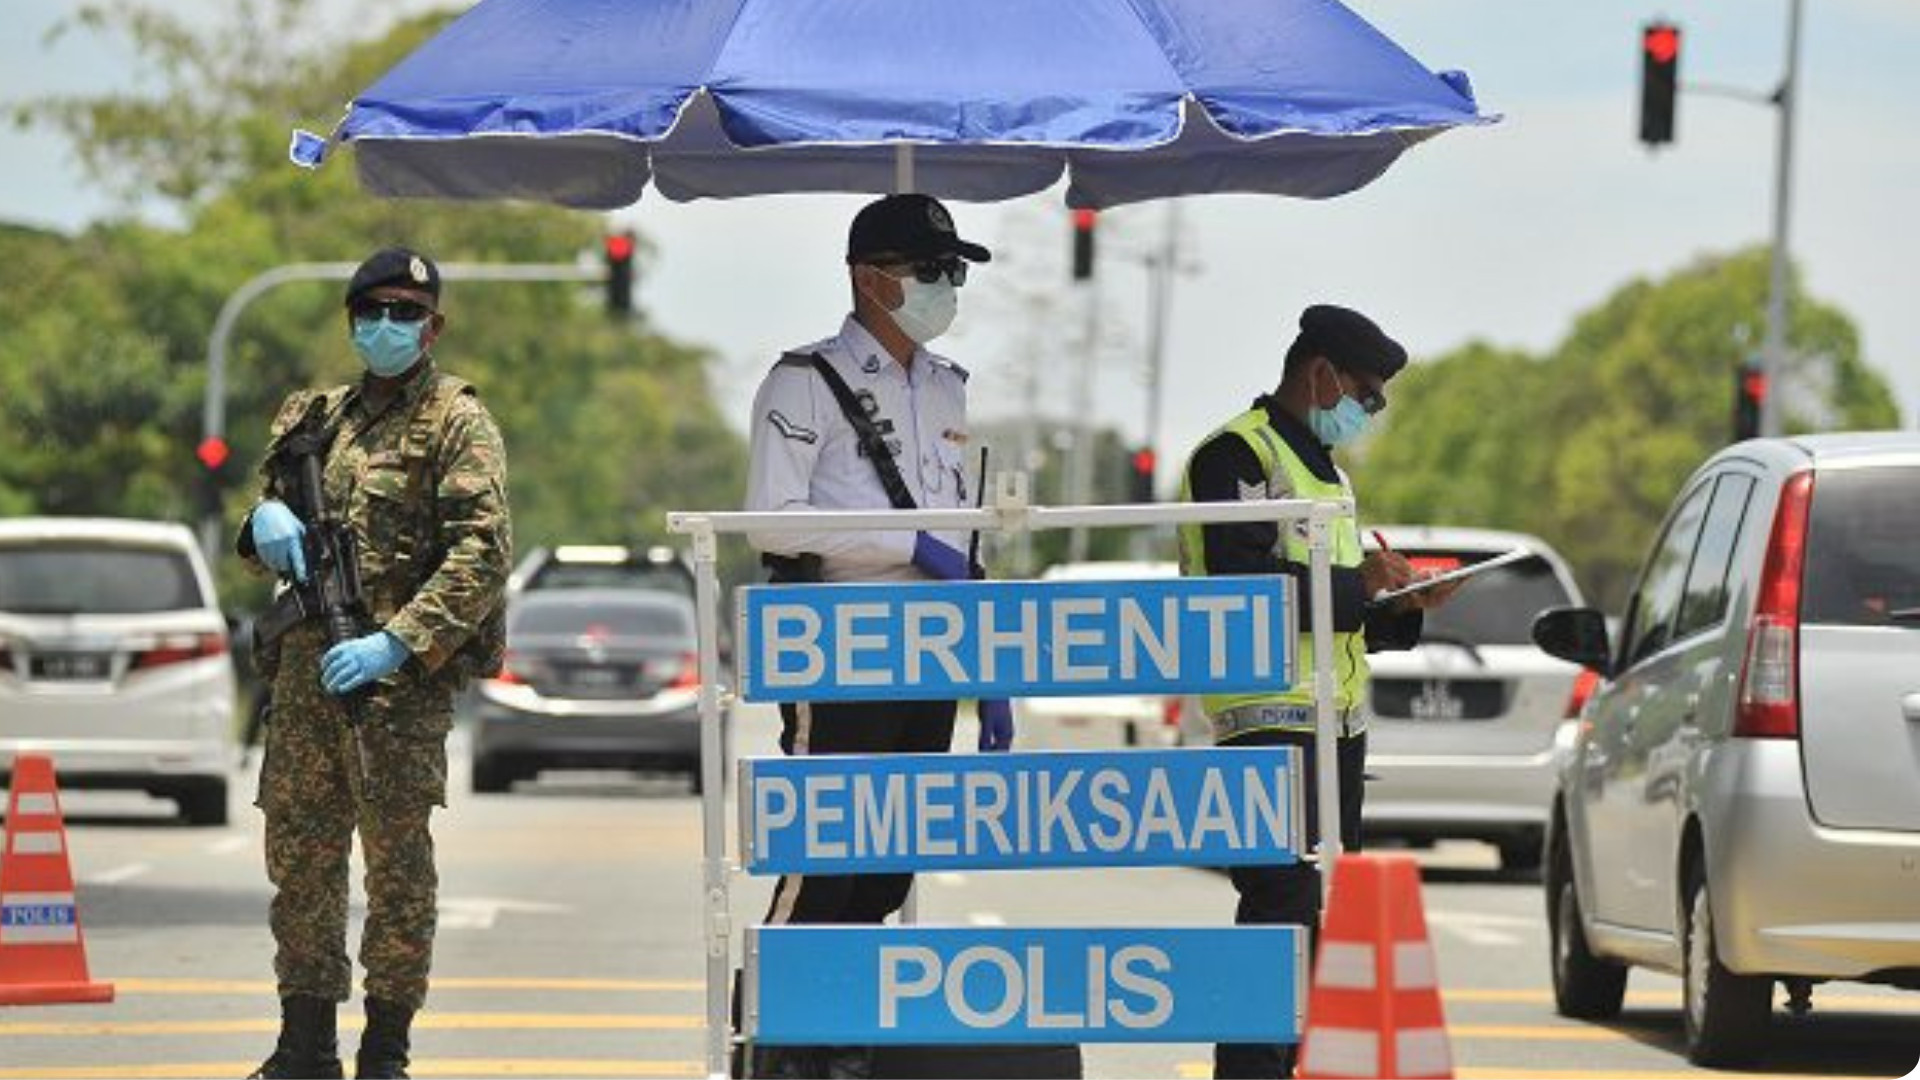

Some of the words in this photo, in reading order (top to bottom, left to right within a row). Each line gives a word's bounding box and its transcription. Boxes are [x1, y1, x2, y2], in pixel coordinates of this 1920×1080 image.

[761, 595, 1271, 686] BERHENTI
[755, 765, 1287, 858] PEMERIKSAAN
[11, 905, 68, 925] POLIS
[878, 944, 1175, 1030] POLIS
